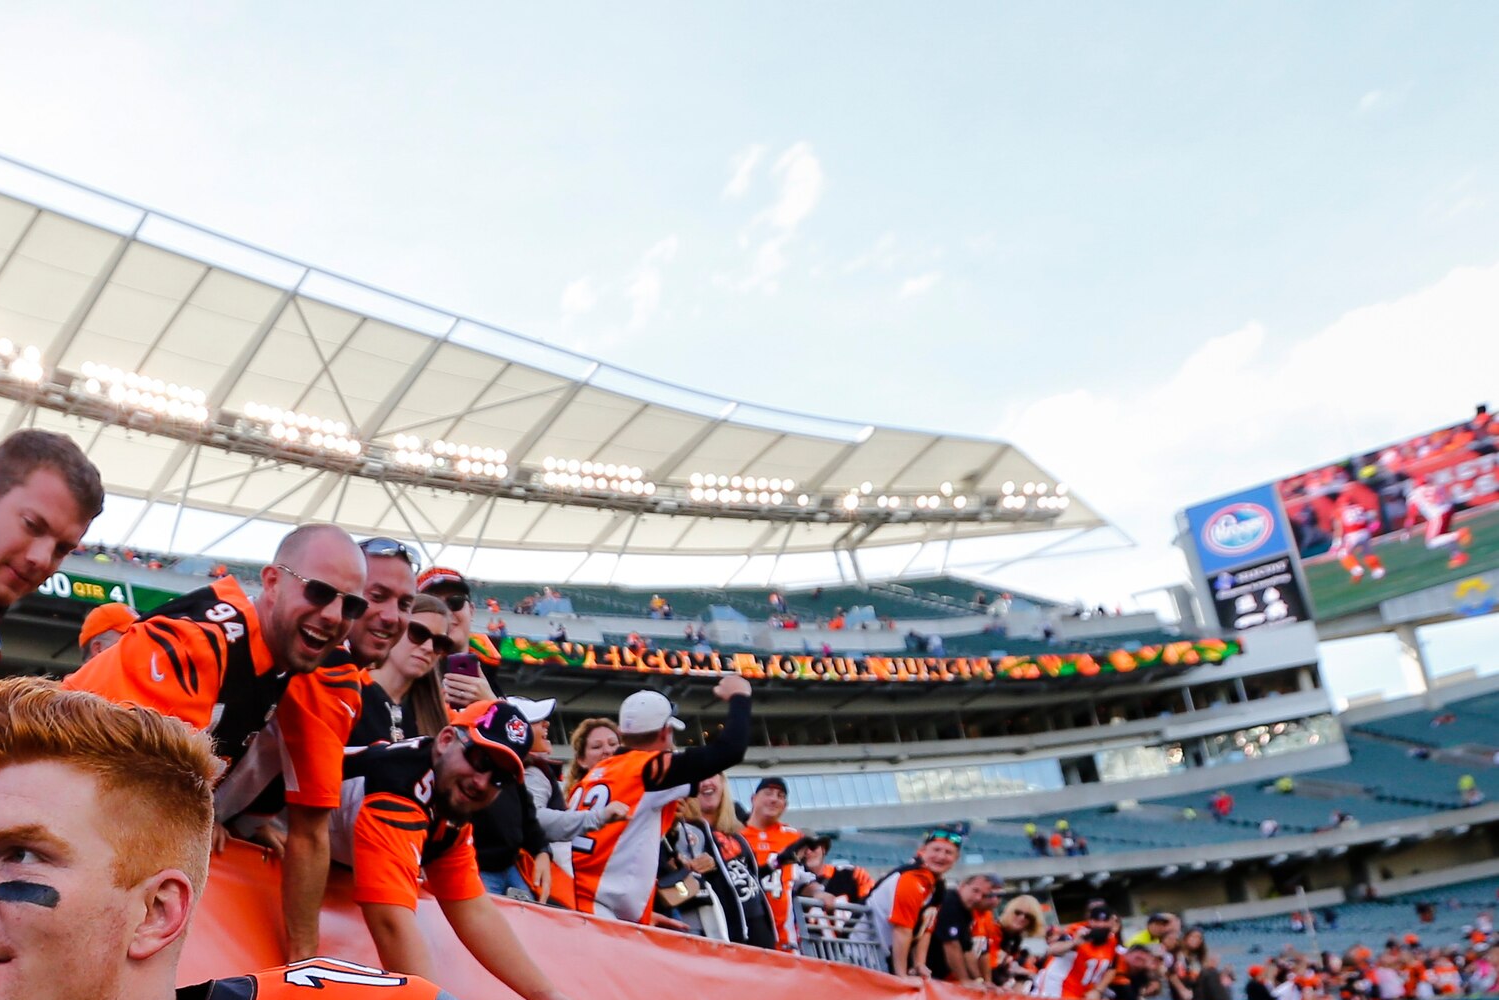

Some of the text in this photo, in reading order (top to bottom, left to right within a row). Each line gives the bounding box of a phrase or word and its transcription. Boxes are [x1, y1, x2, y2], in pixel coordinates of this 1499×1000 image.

[72, 582, 105, 599] QTR
[109, 585, 125, 602] 4
[205, 603, 244, 643] 94
[284, 956, 407, 988] 1
